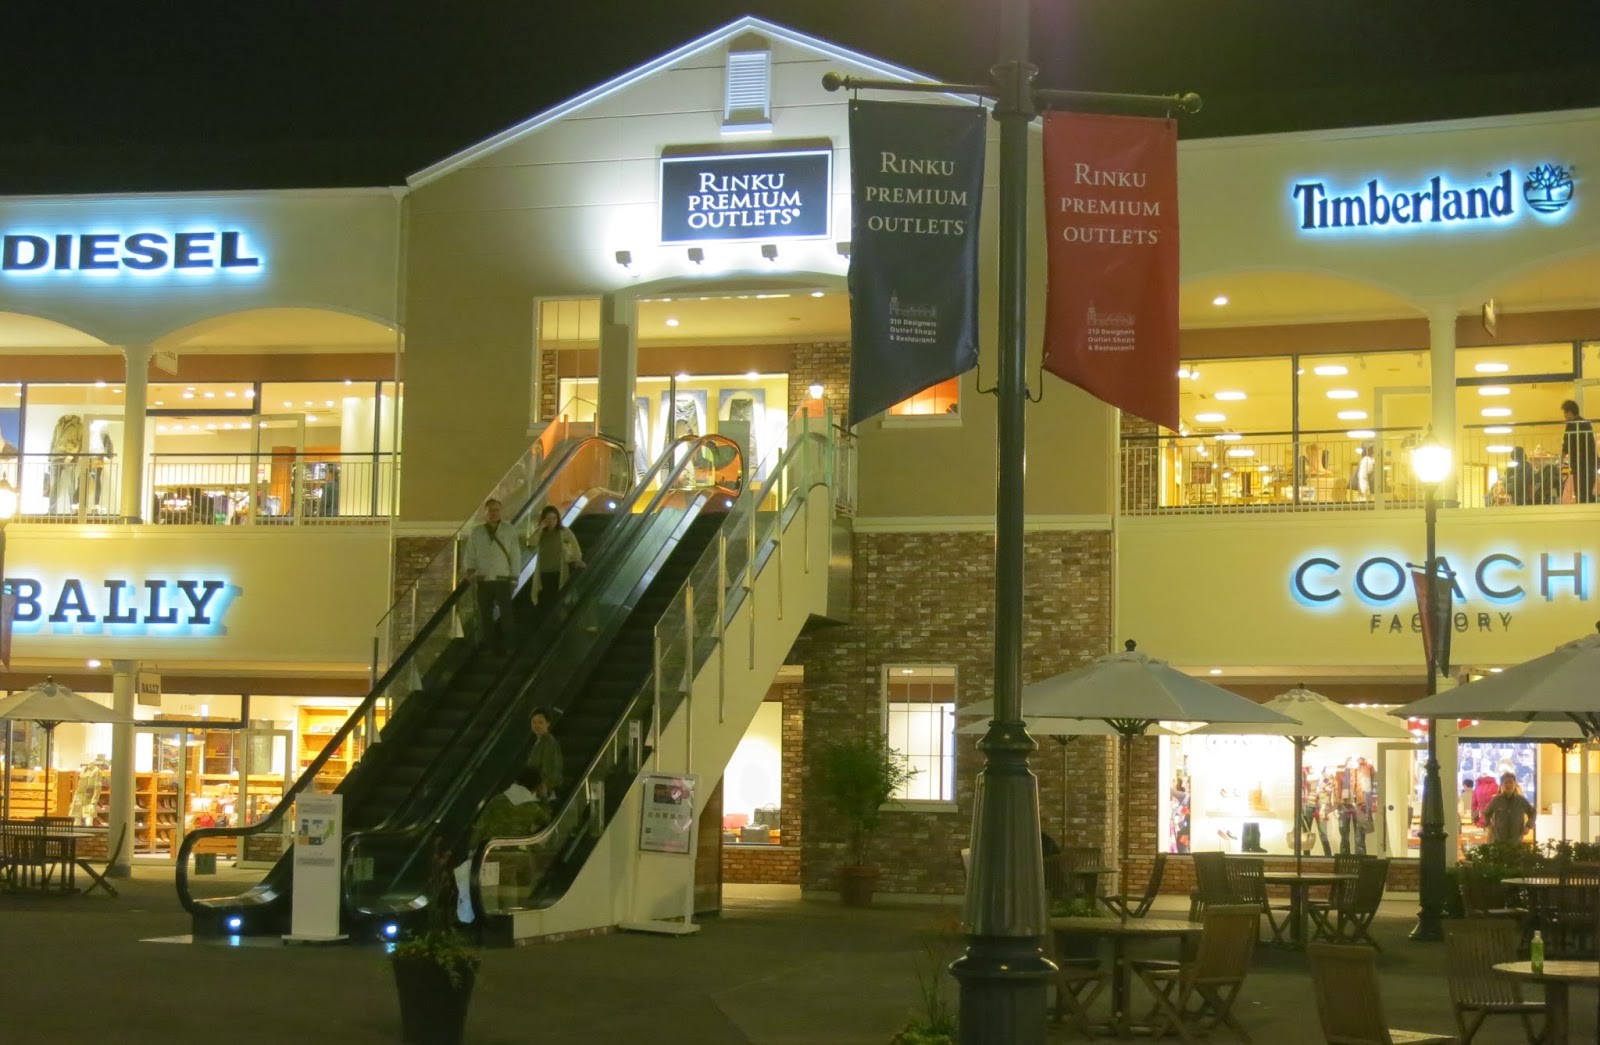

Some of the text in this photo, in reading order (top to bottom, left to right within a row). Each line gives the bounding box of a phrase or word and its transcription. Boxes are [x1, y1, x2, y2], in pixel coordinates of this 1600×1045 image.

[880, 152, 955, 176] RINKU
[699, 172, 785, 193] RINKU
[1074, 163, 1147, 188] RINKU
[688, 190, 802, 212] PREMIUM
[866, 186, 968, 206] PREMIUM
[1293, 169, 1514, 229] Timberland
[1061, 197, 1160, 217] PREMIUM
[868, 215, 965, 236] OUTLETS
[1063, 226, 1158, 245] OUTLETS
[2, 231, 259, 271] DIESEL
[903, 319, 936, 327] Designers
[896, 335, 936, 343] Restaurants
[3, 578, 225, 625] BALLY
[1370, 612, 1512, 632] FACORY
